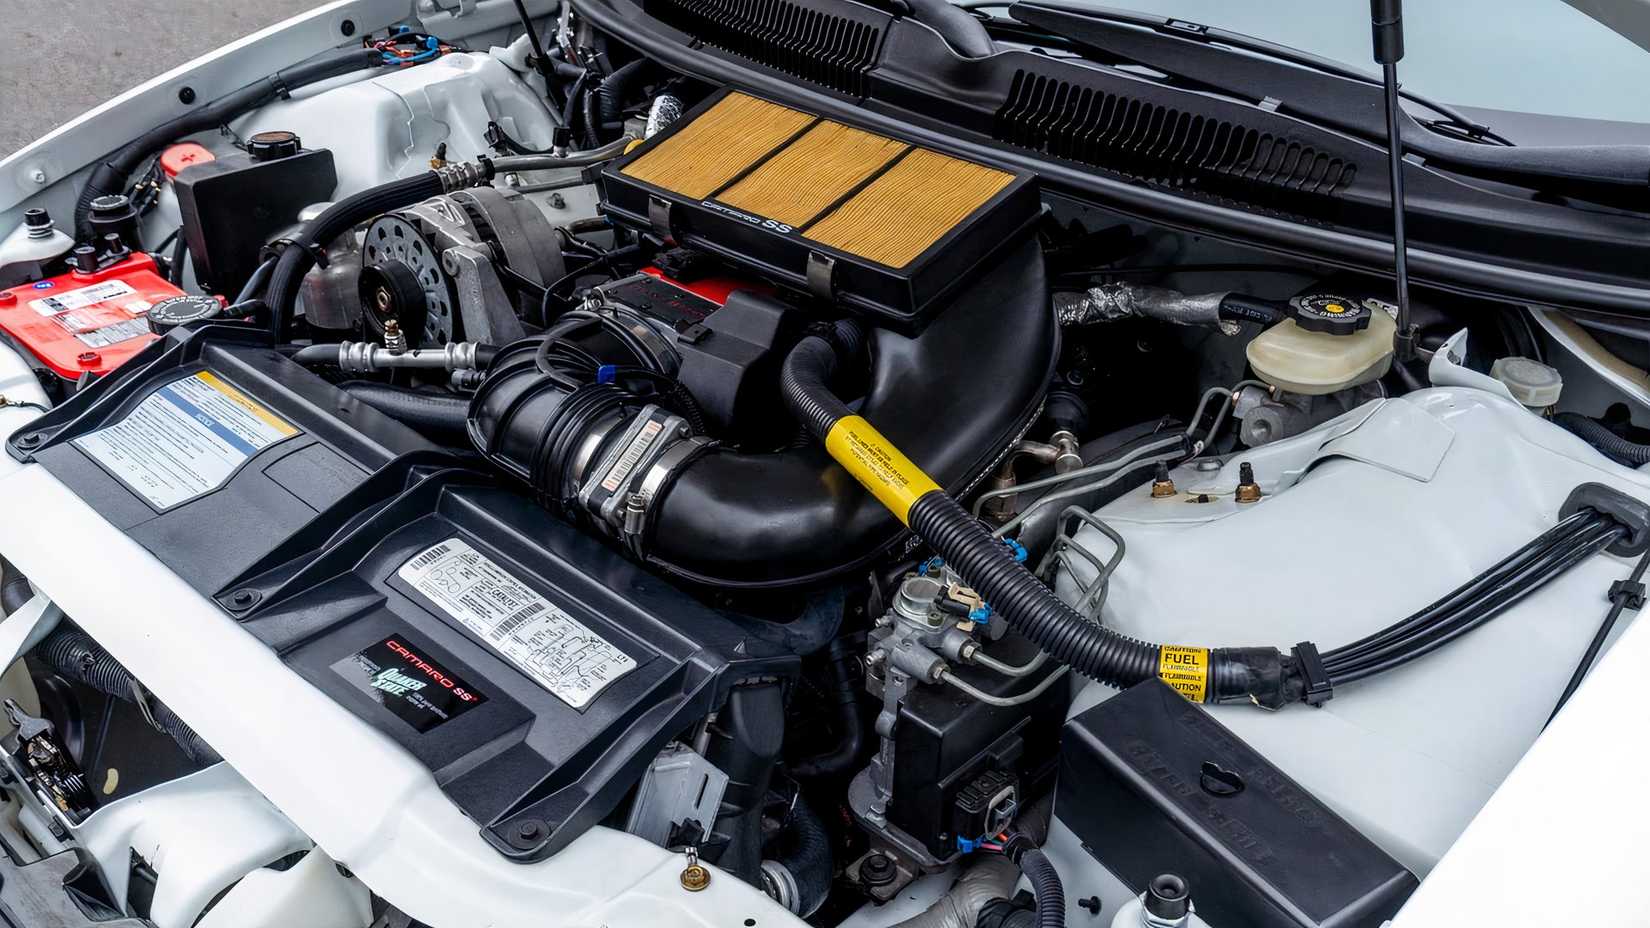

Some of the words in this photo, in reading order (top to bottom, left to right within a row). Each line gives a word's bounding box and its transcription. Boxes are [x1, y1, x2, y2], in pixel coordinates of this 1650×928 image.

[762, 219, 793, 233] SS
[1165, 653, 1199, 665] FUEL
[377, 667, 428, 691] QUAKER
[386, 639, 455, 689] CAMARO
[453, 687, 473, 702] SS
[371, 679, 410, 697] STATE
